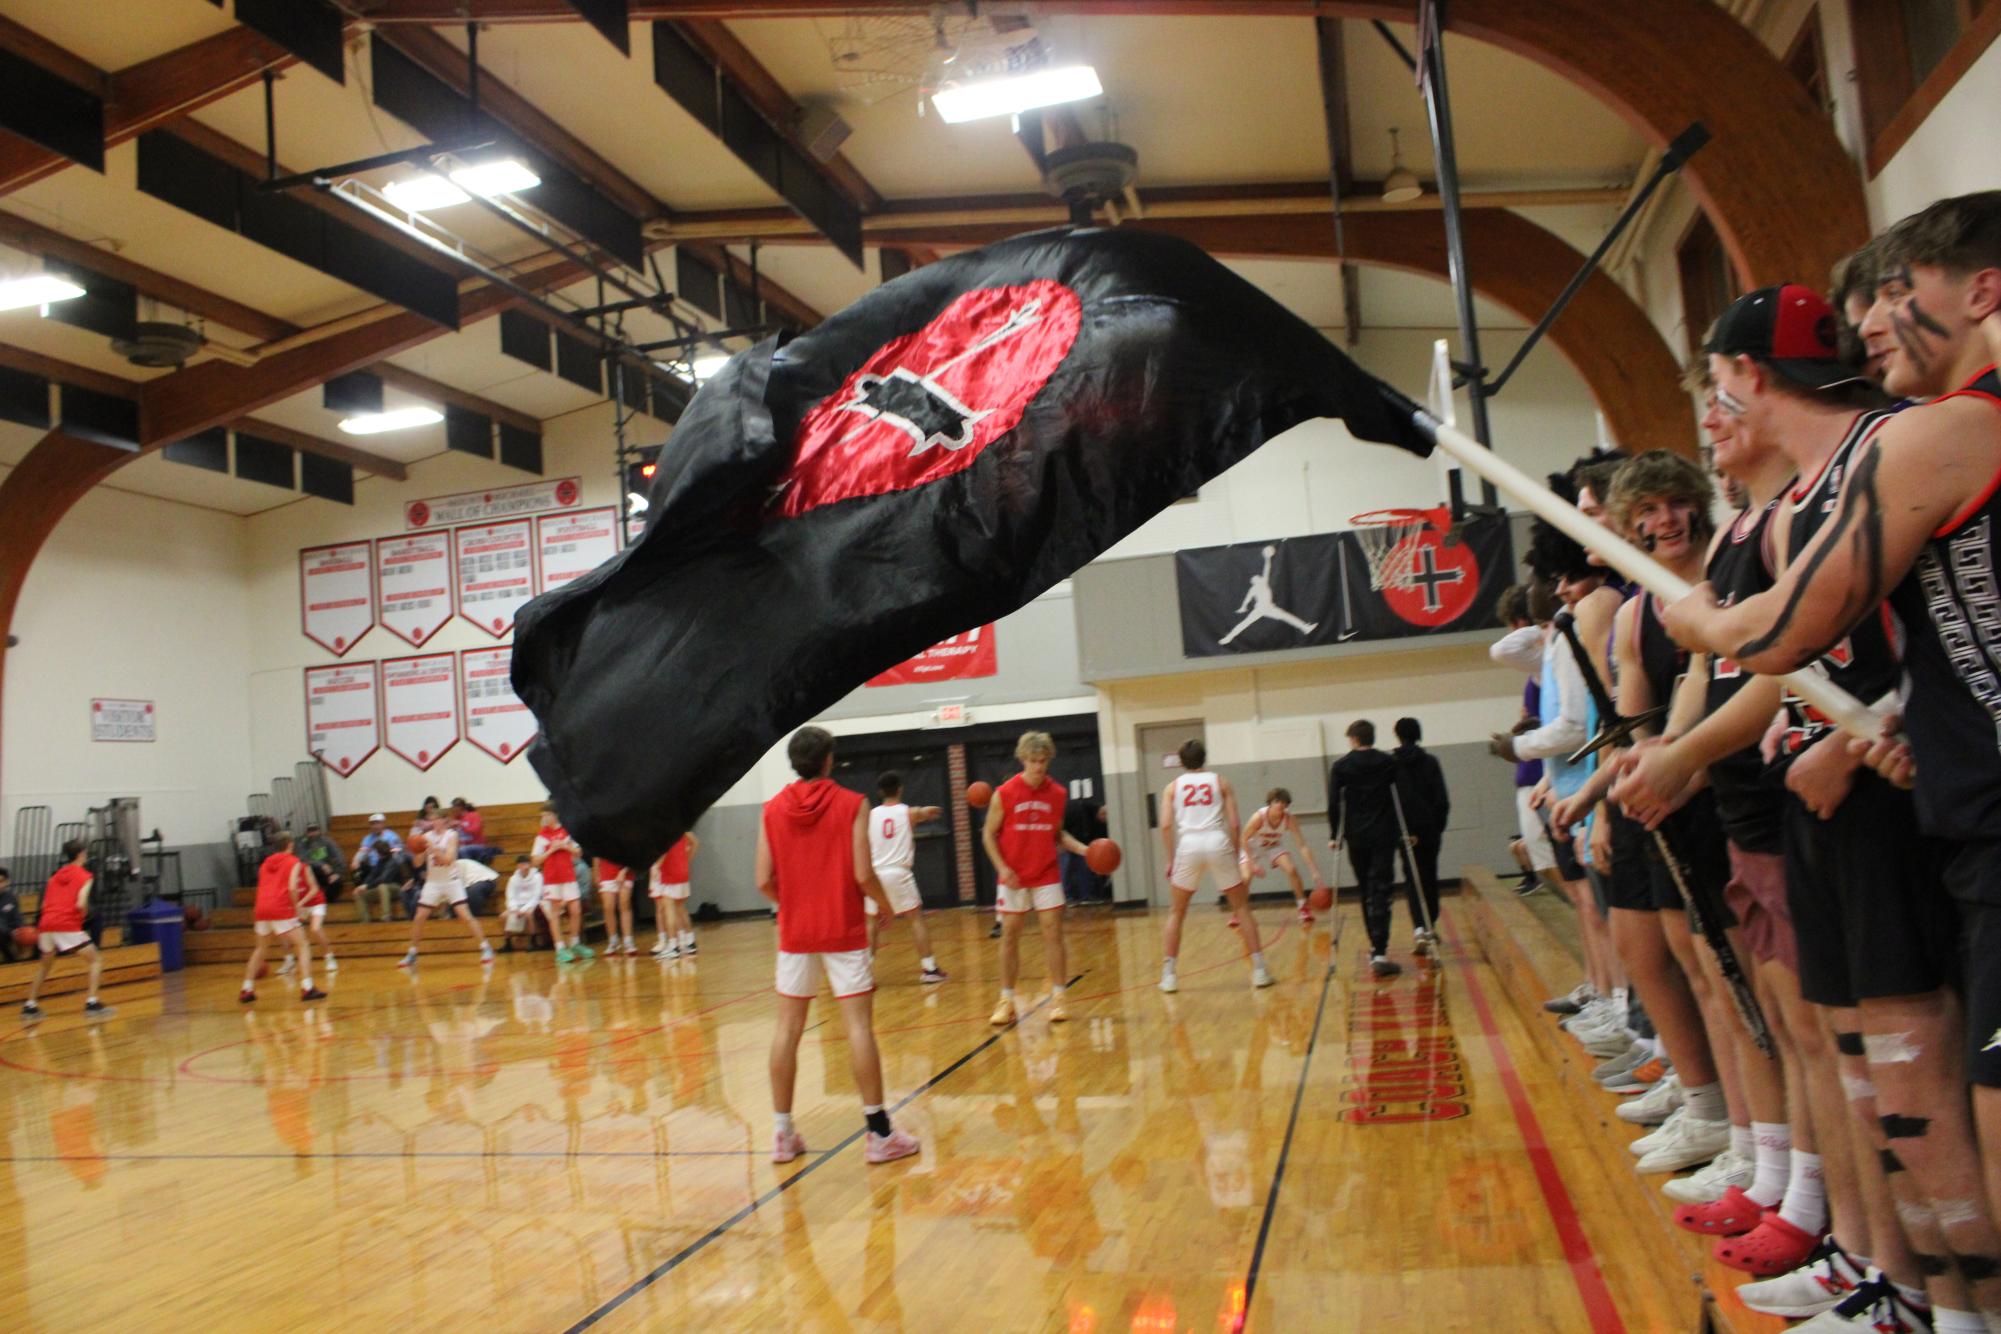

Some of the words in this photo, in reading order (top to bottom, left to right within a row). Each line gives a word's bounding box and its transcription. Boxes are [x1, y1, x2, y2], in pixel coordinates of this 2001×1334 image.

[926, 644, 978, 658] THERAPY
[1183, 783, 1213, 806] 23
[882, 818, 895, 839] 0
